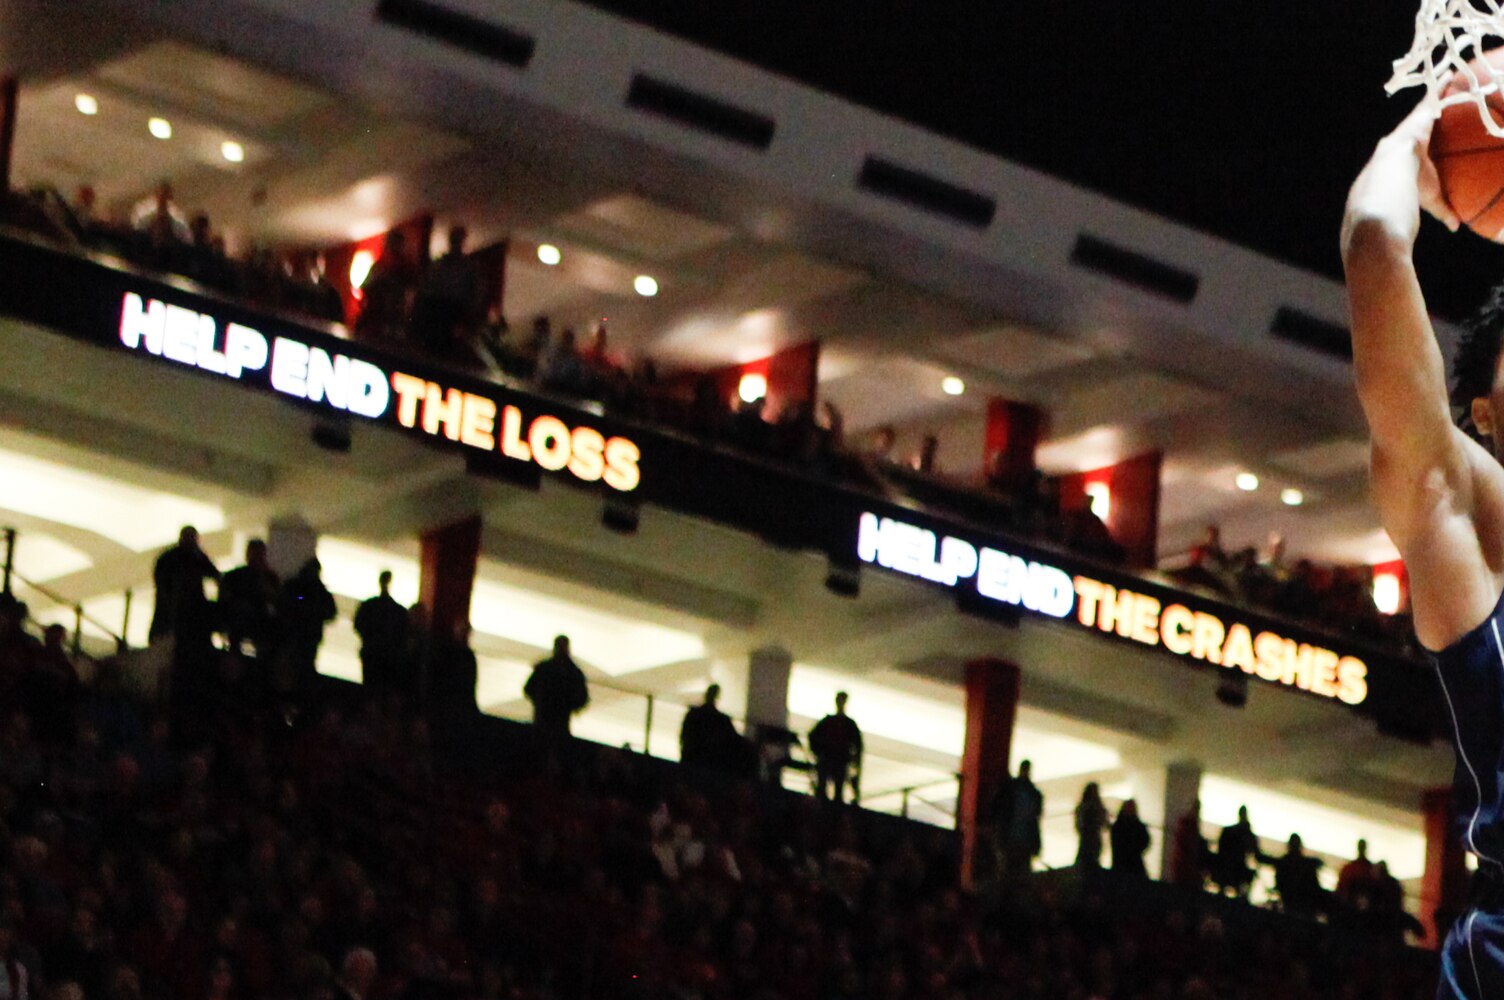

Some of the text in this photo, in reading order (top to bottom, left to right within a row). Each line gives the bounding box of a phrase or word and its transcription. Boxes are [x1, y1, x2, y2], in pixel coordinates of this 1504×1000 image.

[119, 292, 641, 492] HELP END THE LOSS
[857, 511, 1368, 705] HELP END THE CRASHES
